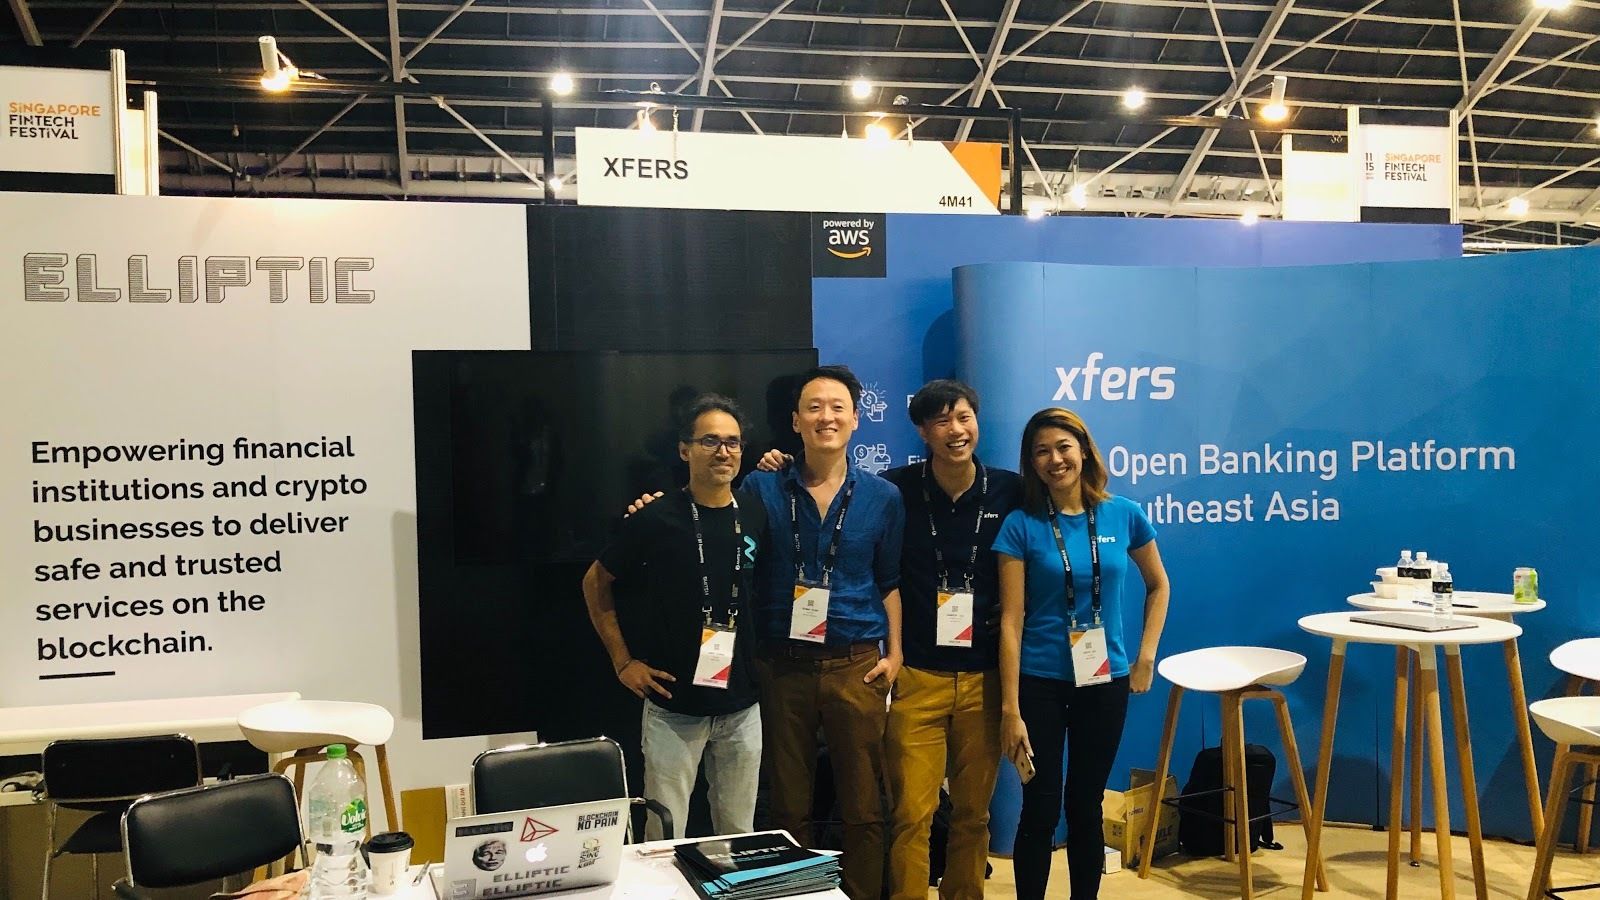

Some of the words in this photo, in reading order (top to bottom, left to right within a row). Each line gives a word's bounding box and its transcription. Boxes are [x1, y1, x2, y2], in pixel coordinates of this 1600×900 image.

[603, 157, 689, 180] XFERS
[938, 196, 973, 208] 4M41
[823, 219, 862, 230] powered
[863, 219, 875, 230] by
[828, 229, 870, 245] aws
[24, 253, 376, 304] ELLIPTIC
[1052, 352, 1176, 401] xfers
[32, 438, 225, 469] Empowering
[233, 435, 356, 460] financial
[1108, 444, 1187, 485] Open
[1200, 441, 1338, 481] Banking
[1351, 438, 1517, 472] Platform
[32, 477, 205, 503] institutions
[212, 474, 268, 499] and
[274, 473, 368, 502] crypto
[1264, 489, 1341, 522] Asia
[33, 518, 205, 543] businesses
[212, 513, 242, 537] to
[249, 511, 349, 536] deliver
[1097, 535, 1116, 543] fers
[34, 557, 101, 582] safe
[109, 554, 167, 579] and
[175, 550, 283, 576] trusted
[36, 595, 164, 621] services
[172, 595, 209, 615] on
[217, 589, 266, 614] the
[37, 630, 214, 661] blockchain.
[577, 821, 591, 831] NO
[594, 817, 618, 829] PAIN
[578, 811, 619, 821] BLOCKCHAIN
[482, 879, 562, 896] ELLIPTIC
[493, 866, 570, 882] ELLIPTIC
